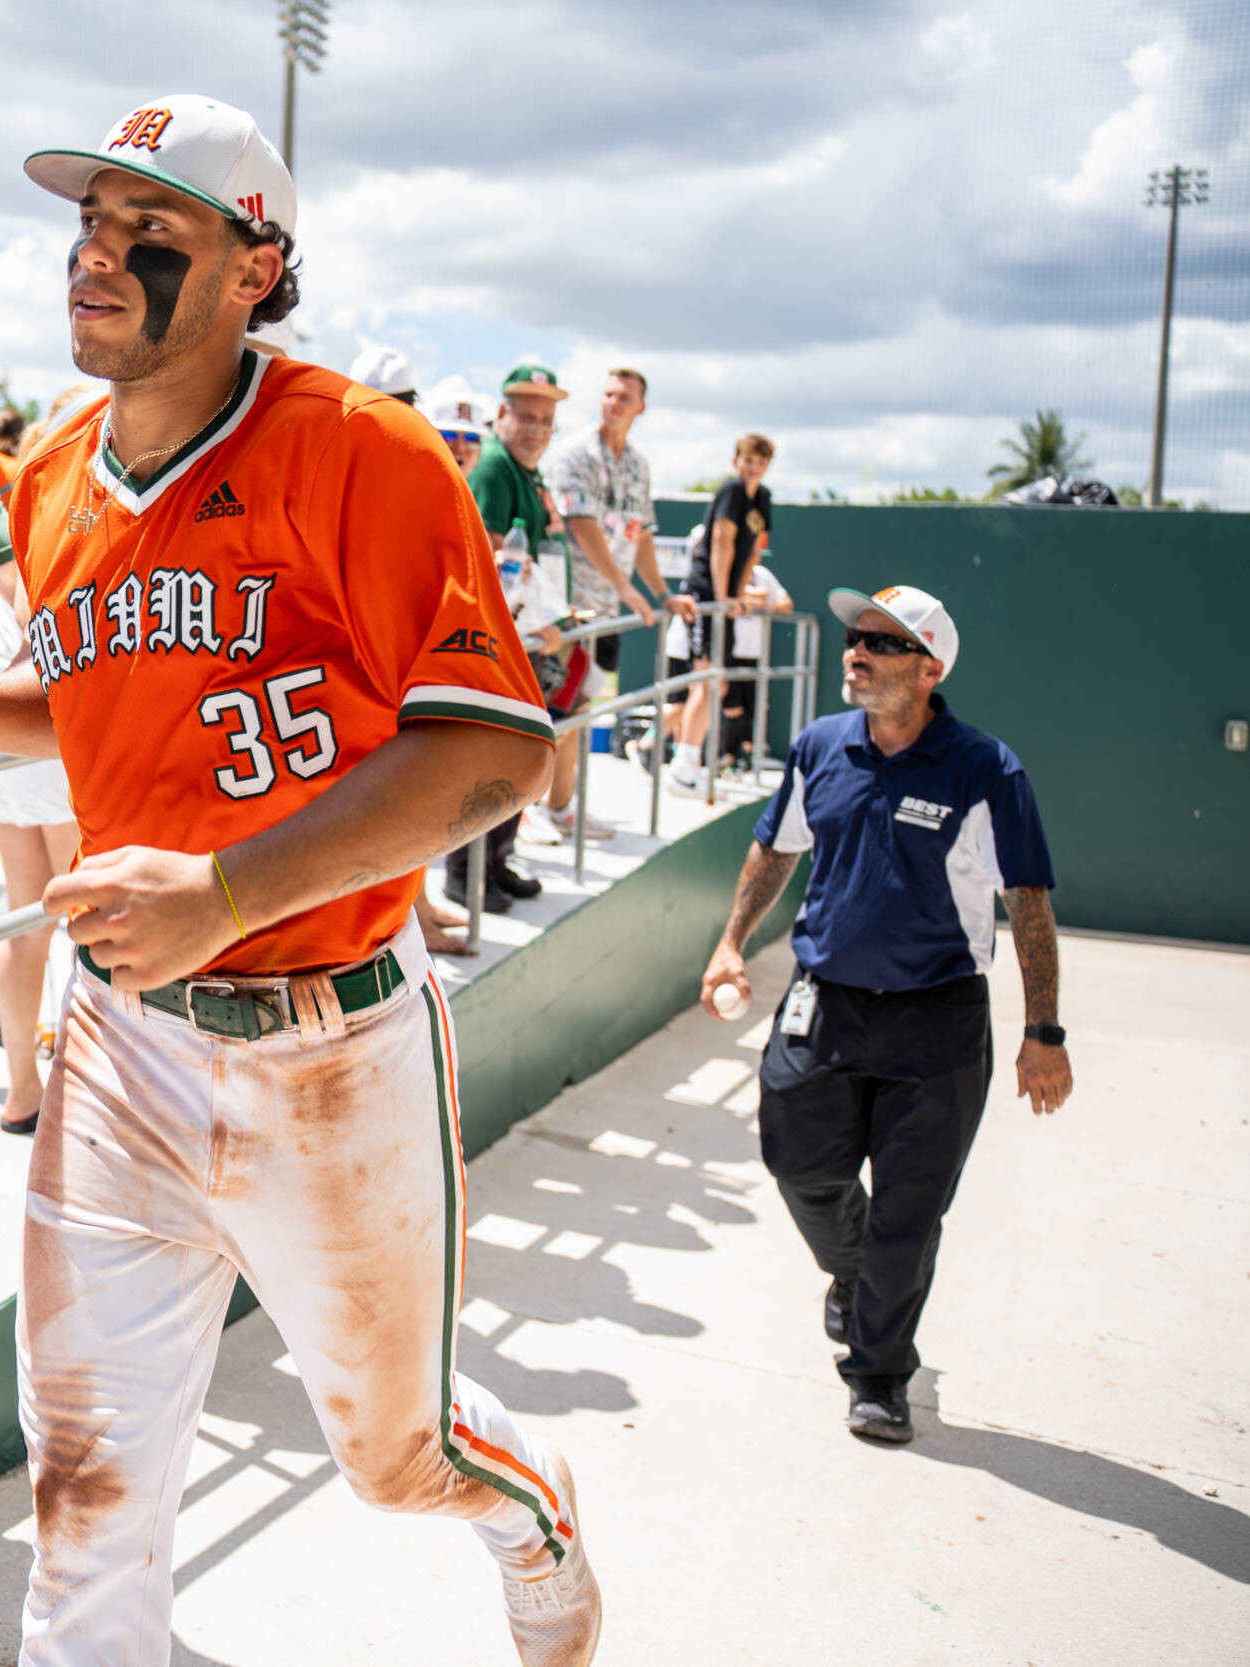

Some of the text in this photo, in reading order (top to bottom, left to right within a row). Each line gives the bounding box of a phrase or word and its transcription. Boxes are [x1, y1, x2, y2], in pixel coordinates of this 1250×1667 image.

[194, 502, 246, 524] adidas
[29, 566, 277, 696] MIAMI
[439, 629, 498, 657] ACC
[198, 664, 339, 801] 35
